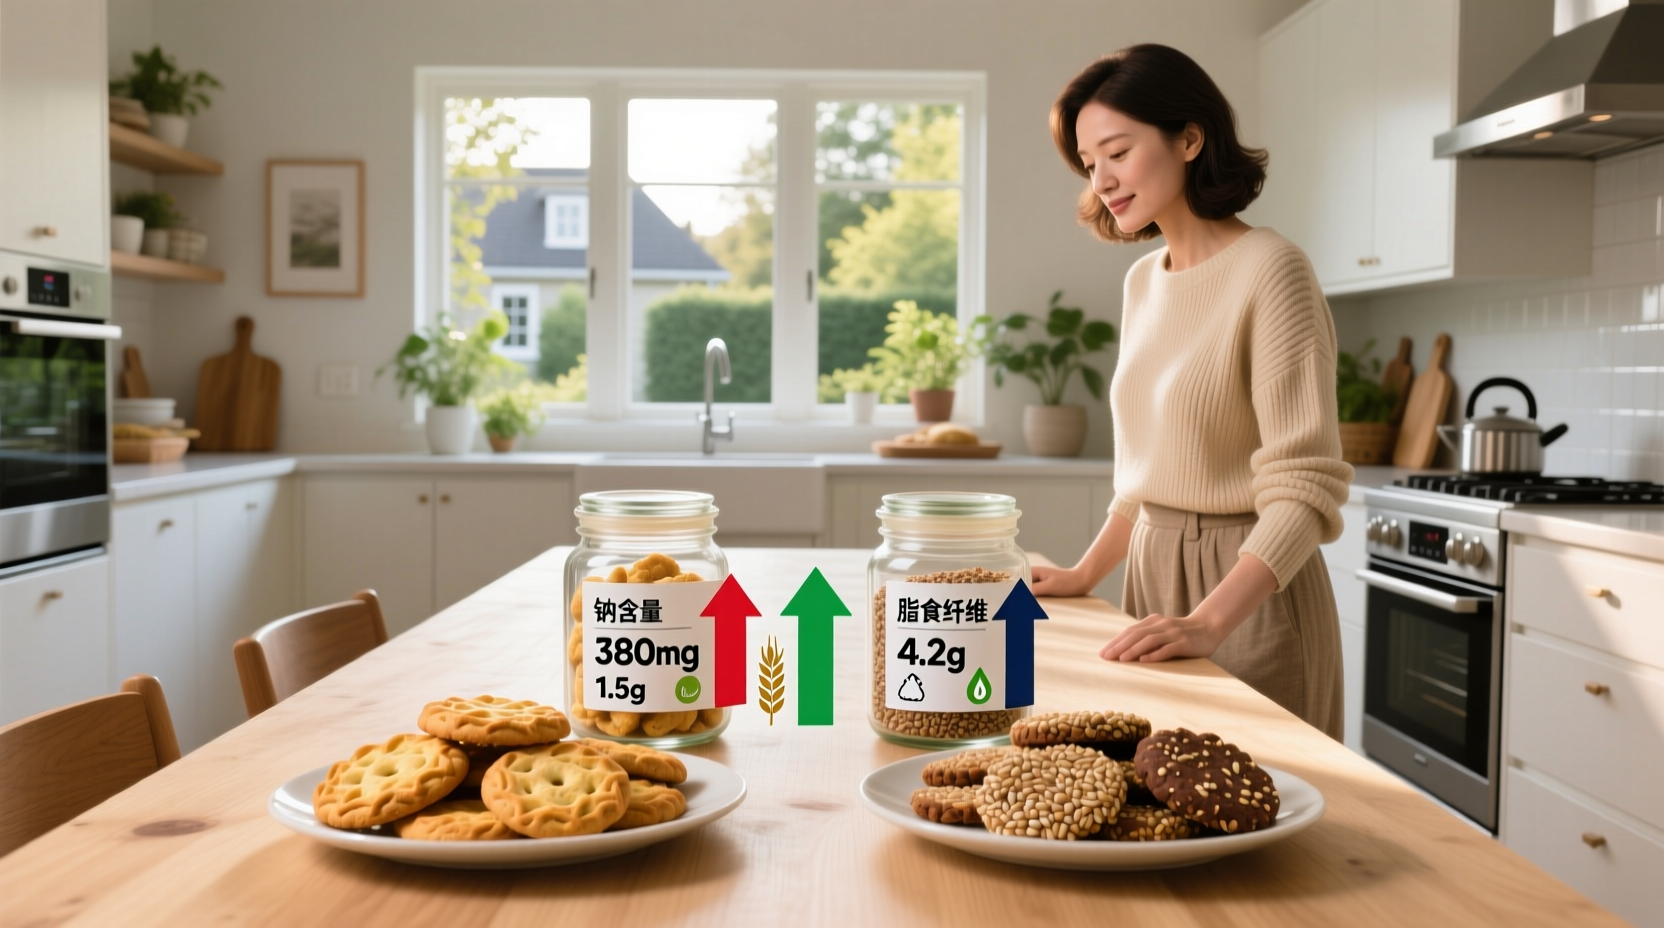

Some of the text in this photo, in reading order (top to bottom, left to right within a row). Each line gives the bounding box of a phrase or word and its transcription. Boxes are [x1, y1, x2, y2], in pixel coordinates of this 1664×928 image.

[594, 597, 663, 623] 钠含量
[897, 597, 988, 624] 脂食纤维
[595, 637, 699, 672] 380mg
[897, 637, 965, 674] 4.2g
[596, 676, 646, 705] 1.5g
